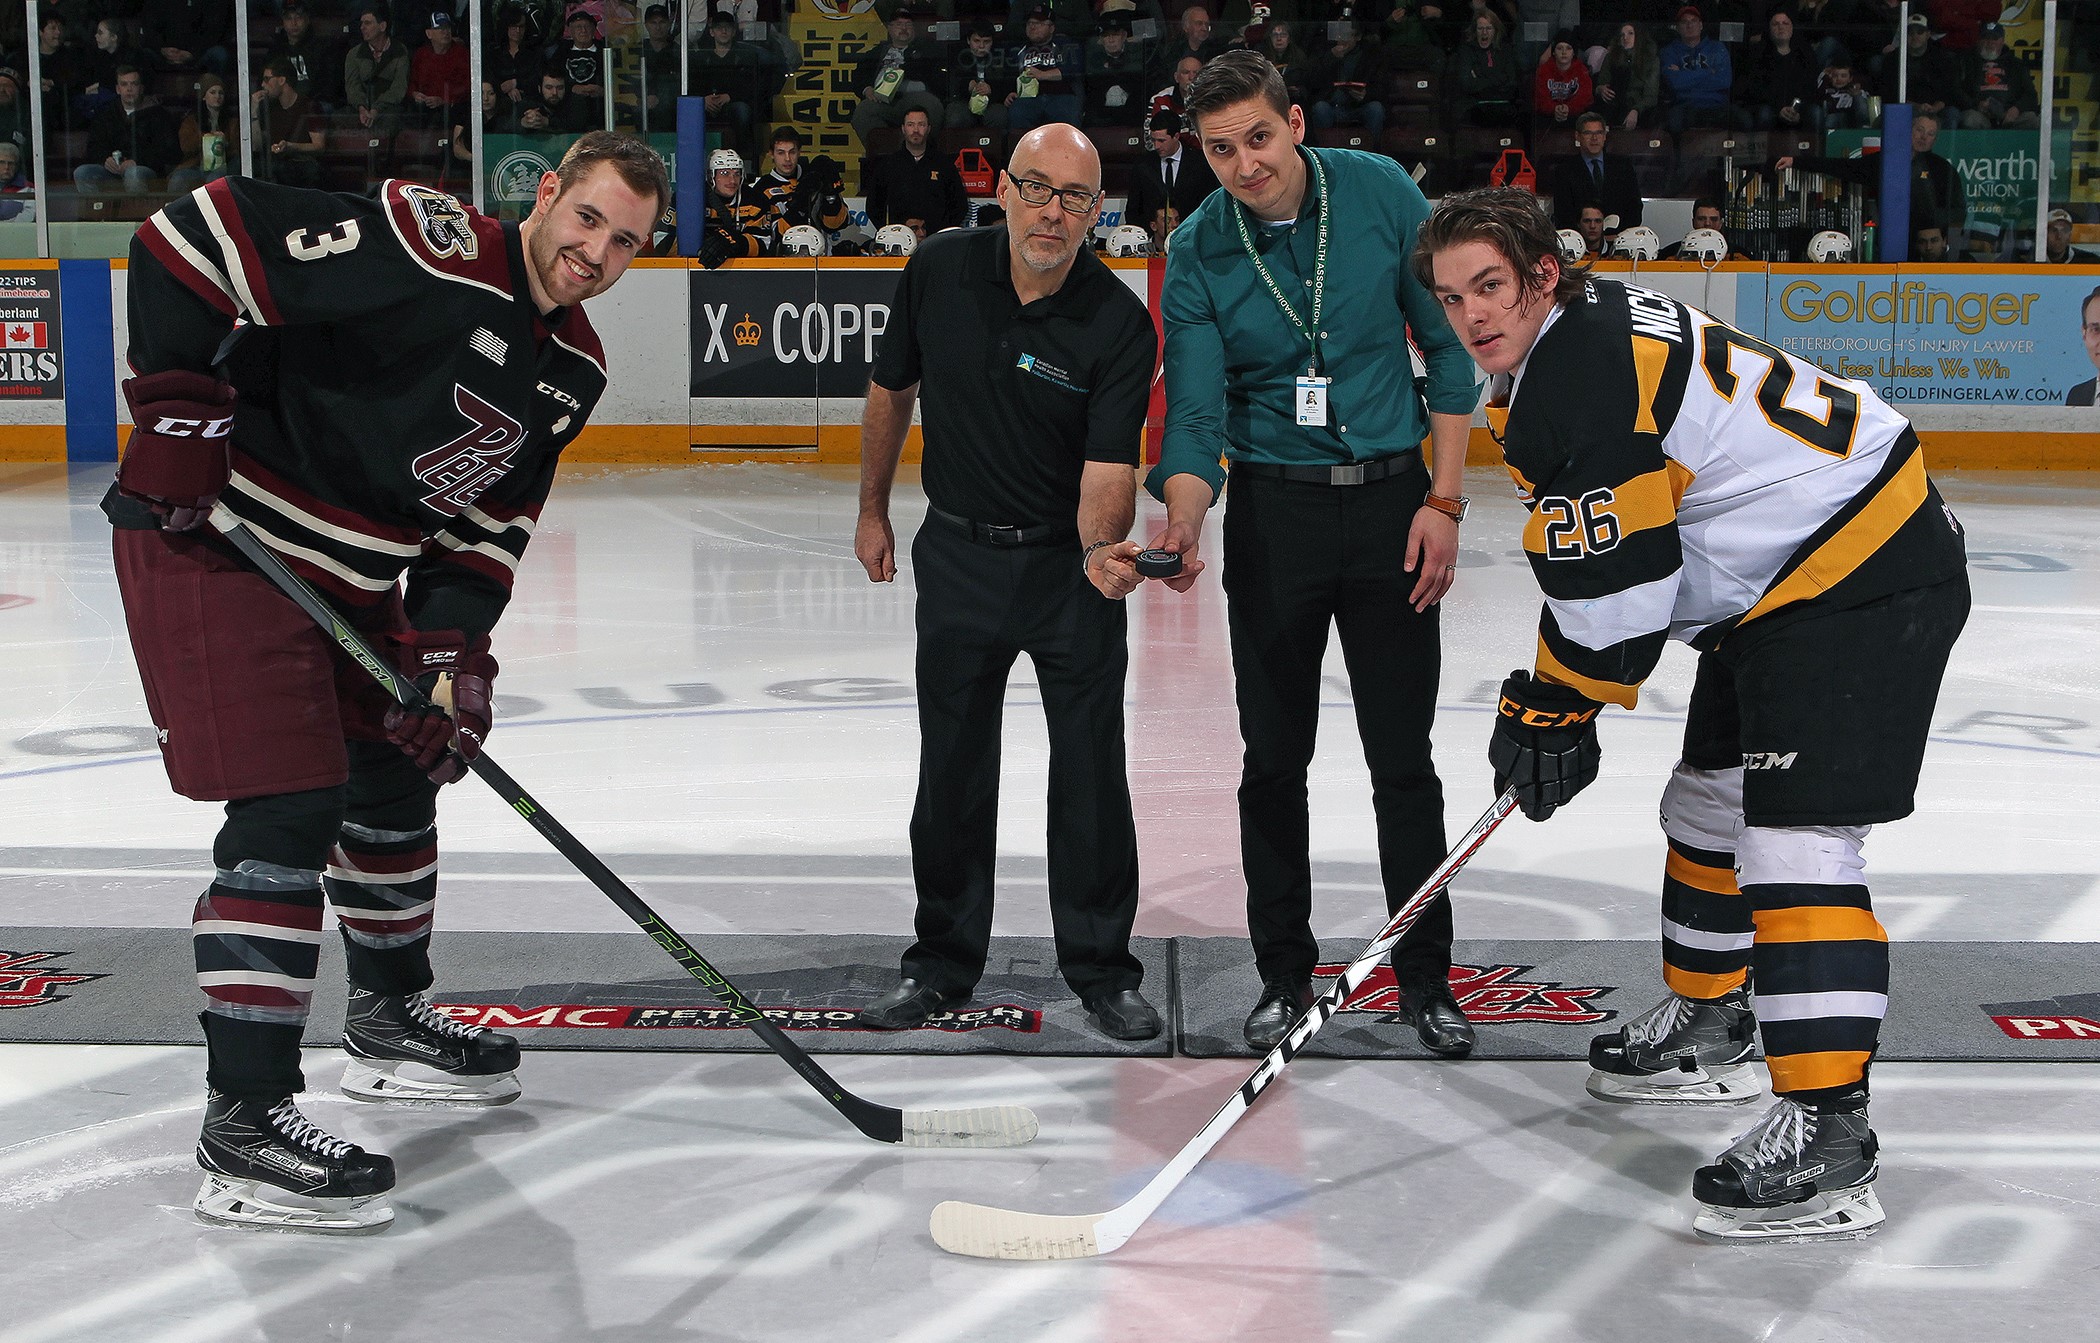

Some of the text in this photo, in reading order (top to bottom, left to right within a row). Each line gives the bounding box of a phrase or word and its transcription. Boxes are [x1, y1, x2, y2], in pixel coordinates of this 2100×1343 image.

[793, 30, 834, 146] IANT
[1319, 185, 1329, 224] MENTAL
[1966, 183, 2019, 198] UNION
[286, 218, 361, 262] 3
[1237, 220, 1253, 253] HEALTH
[1318, 225, 1328, 262] HEALTH
[1251, 252, 1275, 287] MENTAL
[1270, 286, 1303, 327] CANADIAN
[1313, 262, 1326, 325] ASSOCIATION
[1780, 280, 2040, 335] Goldfinger
[703, 302, 891, 364] X COPP
[1782, 336, 2034, 353] PETERBOROUGH'S INJURY LAWYER
[1838, 356, 1873, 377] Fees
[1879, 356, 1933, 378] Unless
[1938, 357, 1969, 379] We
[1973, 358, 2010, 379] Win
[536, 381, 581, 411] CCM
[1699, 323, 1861, 461] 2
[1881, 386, 2063, 402] GOLDFINGERLAW.COM
[1540, 486, 1621, 561] 26
[339, 634, 391, 682] CCM
[422, 650, 459, 660] CCM
[1500, 696, 1597, 727] CCM
[1742, 751, 1798, 770] CCM
[640, 912, 763, 1022] CCM
[434, 1005, 1024, 1026] PMC PETRBOUGH
[634, 1019, 840, 1029] MEMOIAL
[1245, 971, 1352, 1106] CCM
[1662, 1046, 1697, 1059] BAUER
[260, 1150, 298, 1168] BAUER
[1788, 1165, 1824, 1185] BAUER
